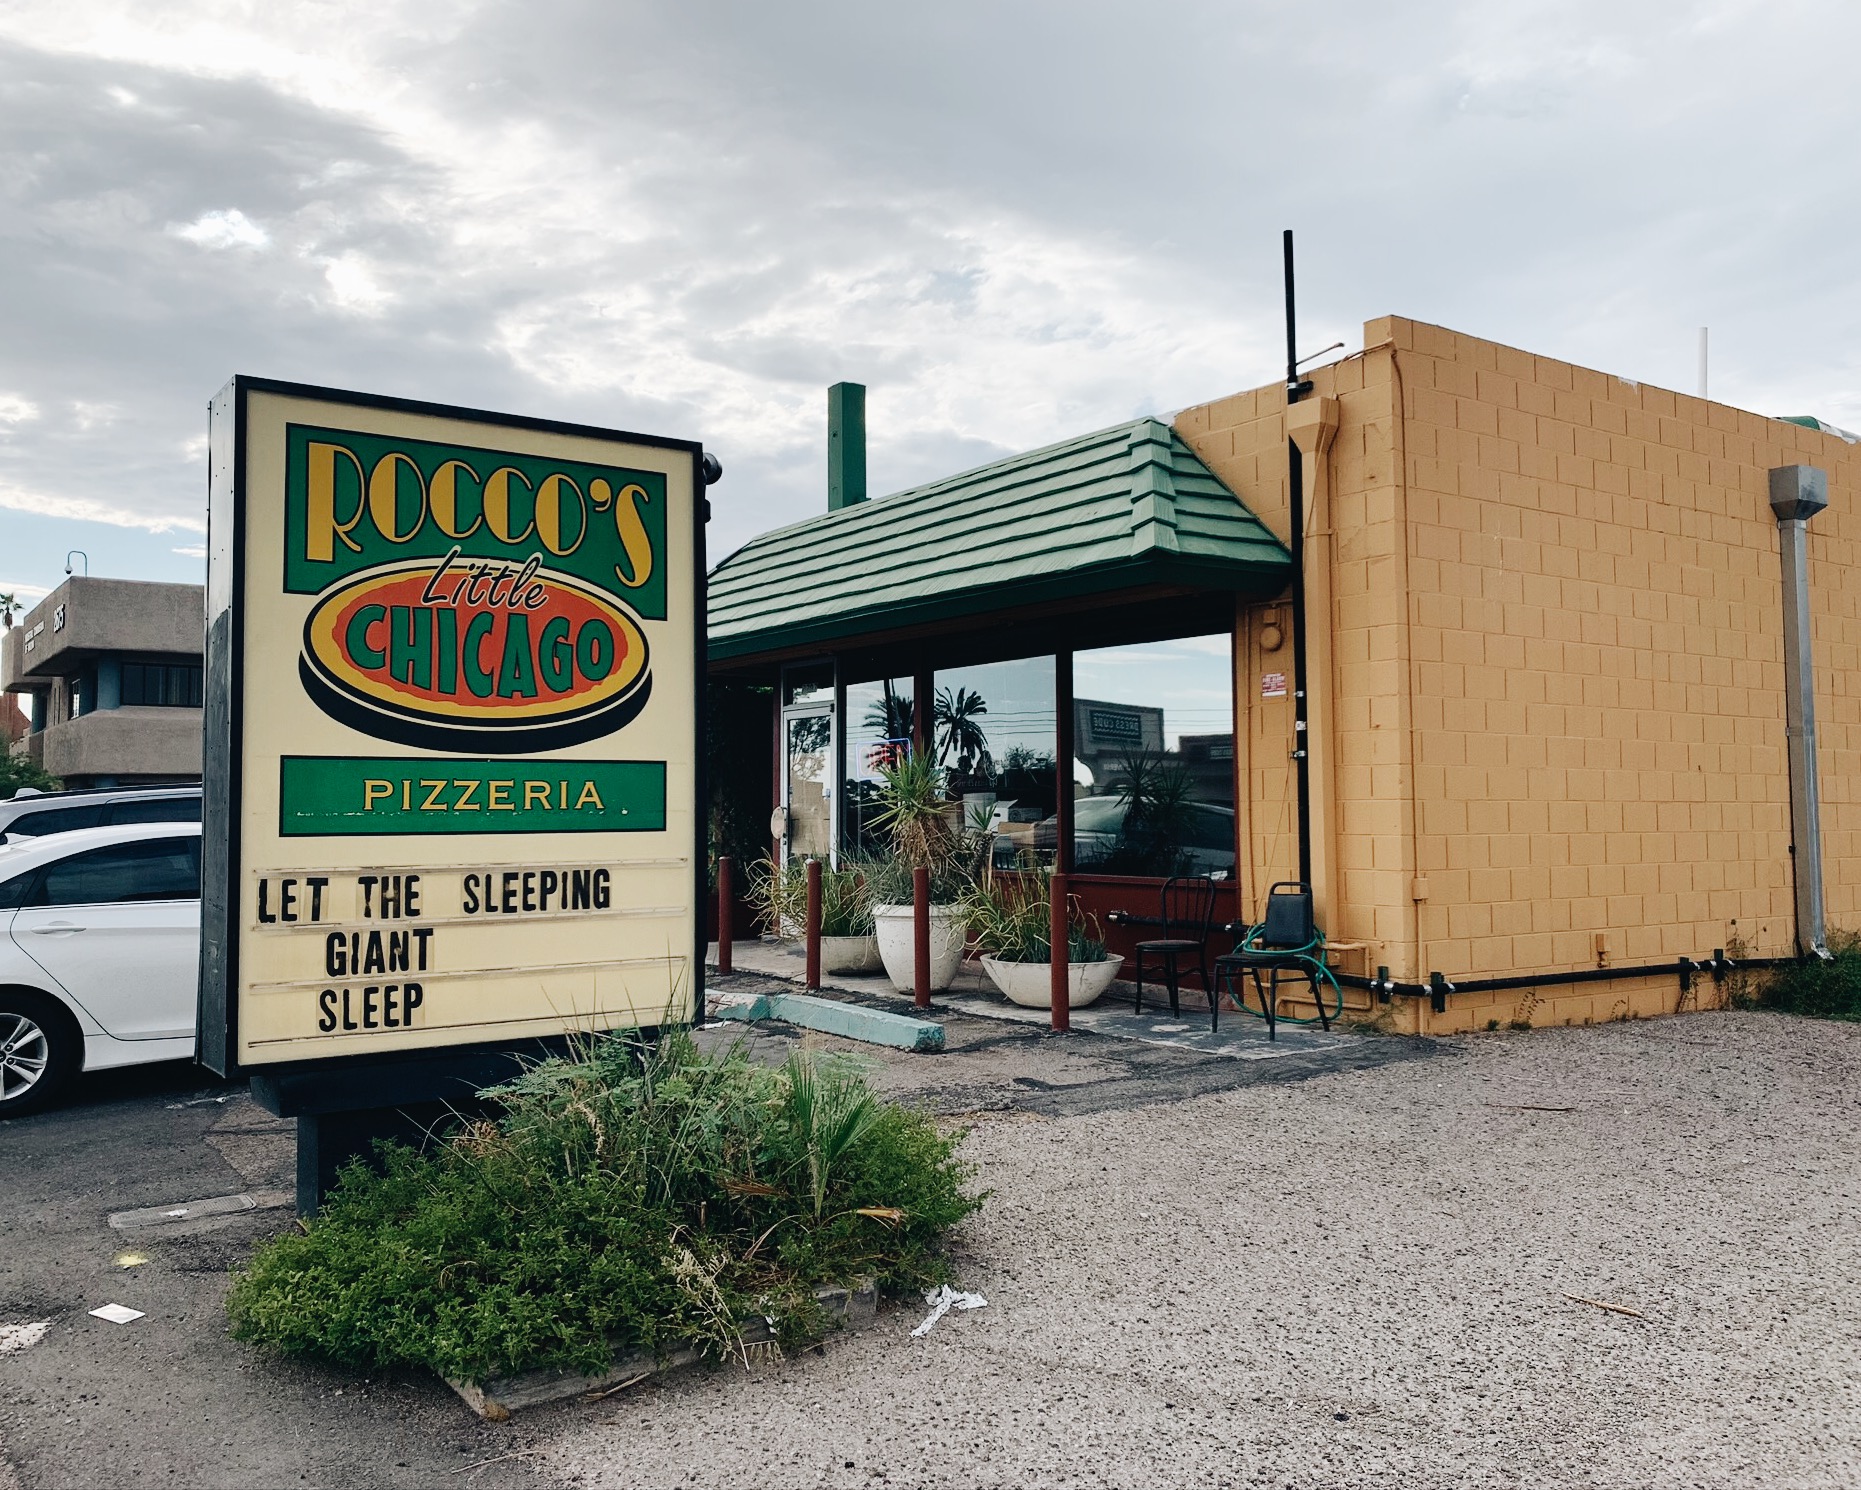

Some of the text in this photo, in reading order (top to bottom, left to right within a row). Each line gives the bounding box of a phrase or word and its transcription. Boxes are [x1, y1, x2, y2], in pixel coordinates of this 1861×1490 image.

[305, 440, 653, 588] ROCCO'S
[421, 545, 549, 611] Little
[345, 604, 615, 698] CHICAGO
[362, 778, 605, 811] PIZZERIA
[258, 868, 611, 924] LET THE SLEEPING
[325, 928, 434, 977] GIANT
[318, 983, 424, 1033] SLEEP
